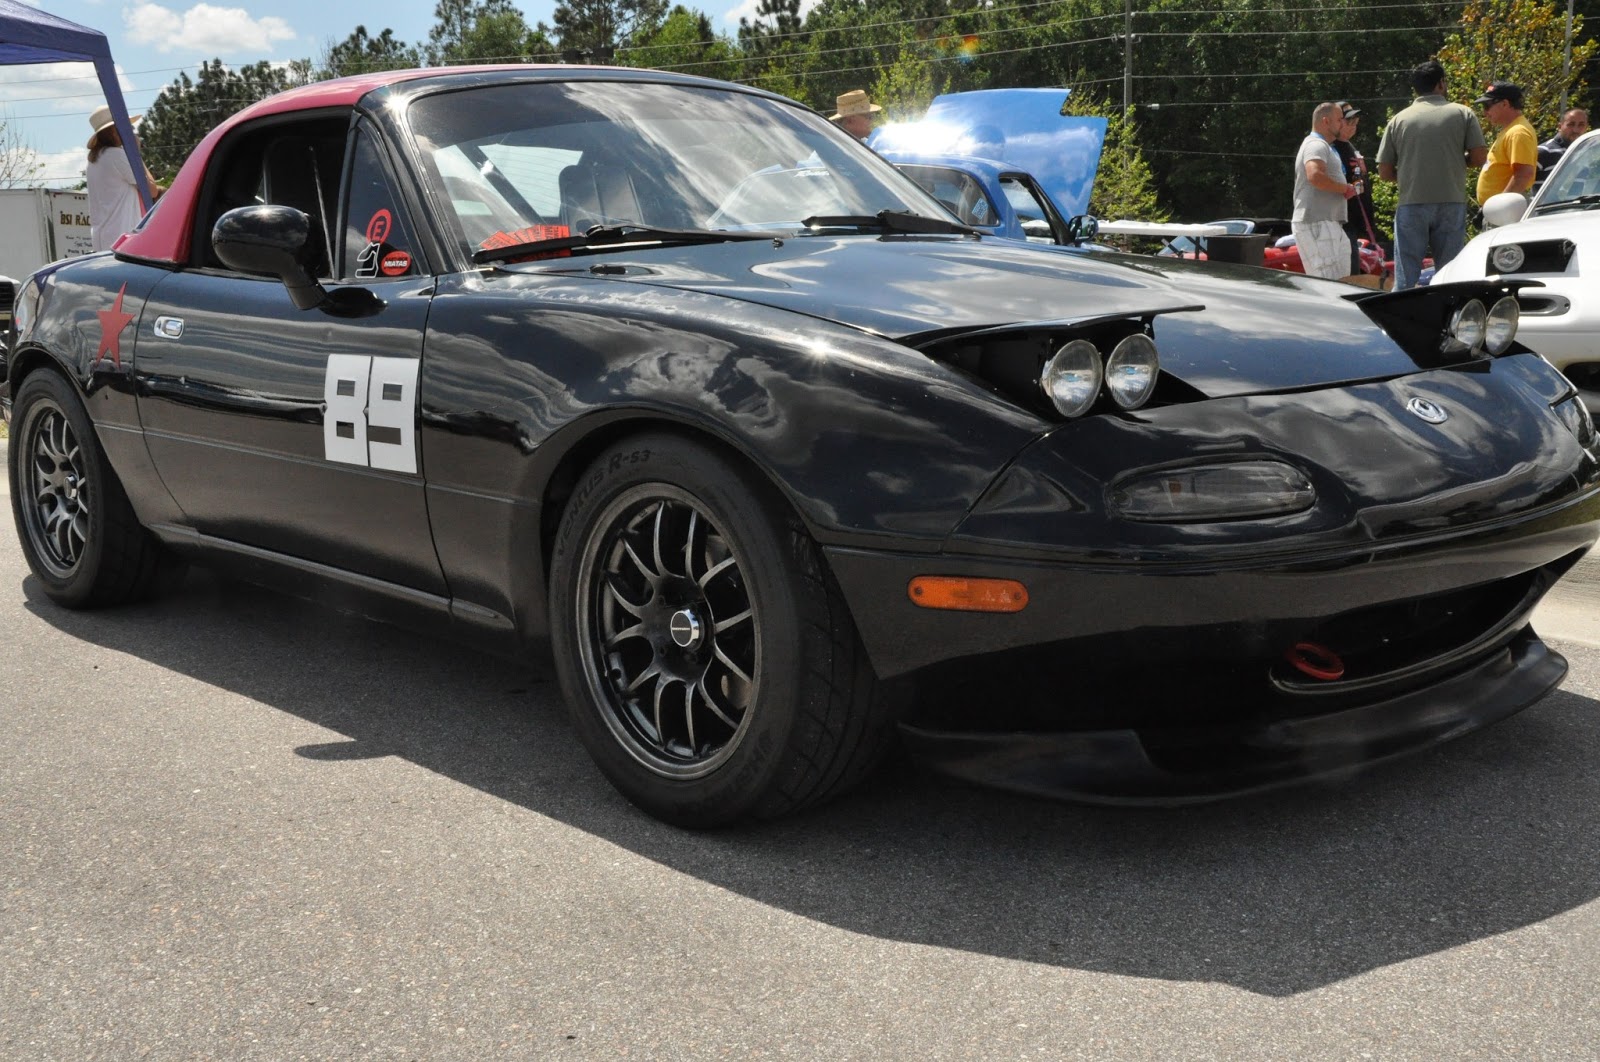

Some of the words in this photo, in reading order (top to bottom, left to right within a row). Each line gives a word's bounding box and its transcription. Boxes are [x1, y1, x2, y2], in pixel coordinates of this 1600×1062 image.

[60, 213, 72, 225] BSI
[372, 220, 385, 241] E
[323, 353, 420, 474] 89
